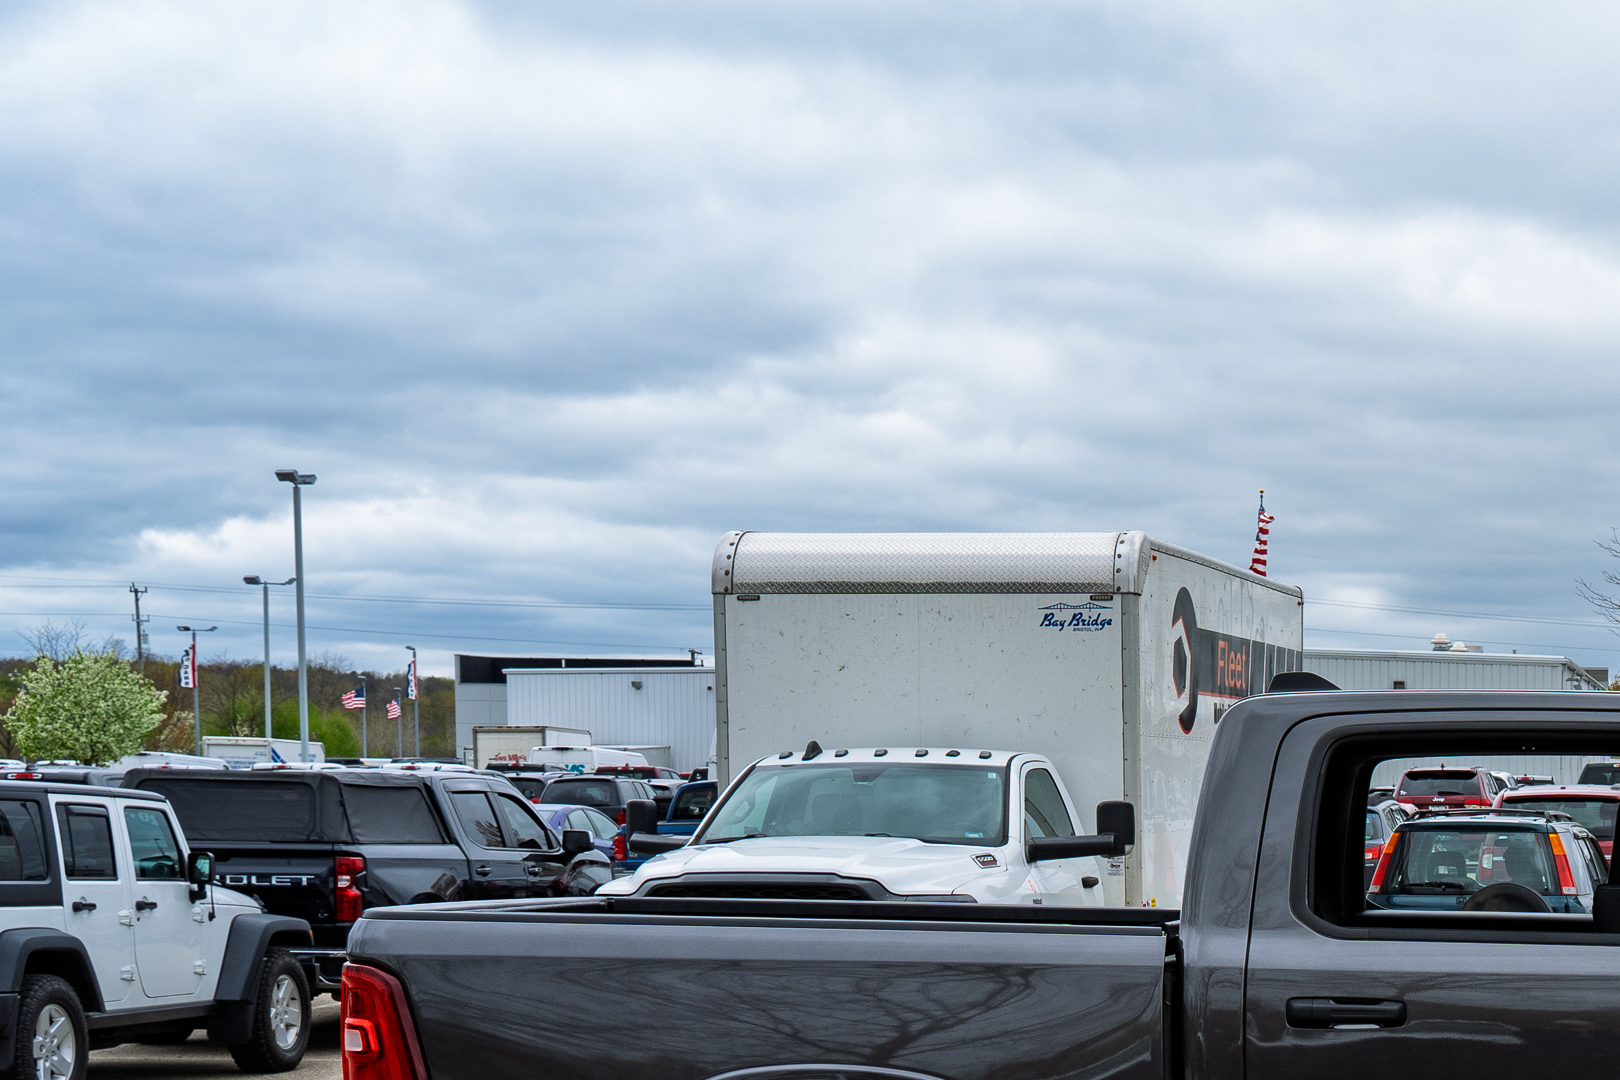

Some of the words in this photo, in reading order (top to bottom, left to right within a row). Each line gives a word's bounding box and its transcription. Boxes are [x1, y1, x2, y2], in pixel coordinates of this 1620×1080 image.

[1039, 612, 1067, 631] Bay
[1067, 612, 1113, 631] Bridge
[1217, 640, 1246, 690] Fleet
